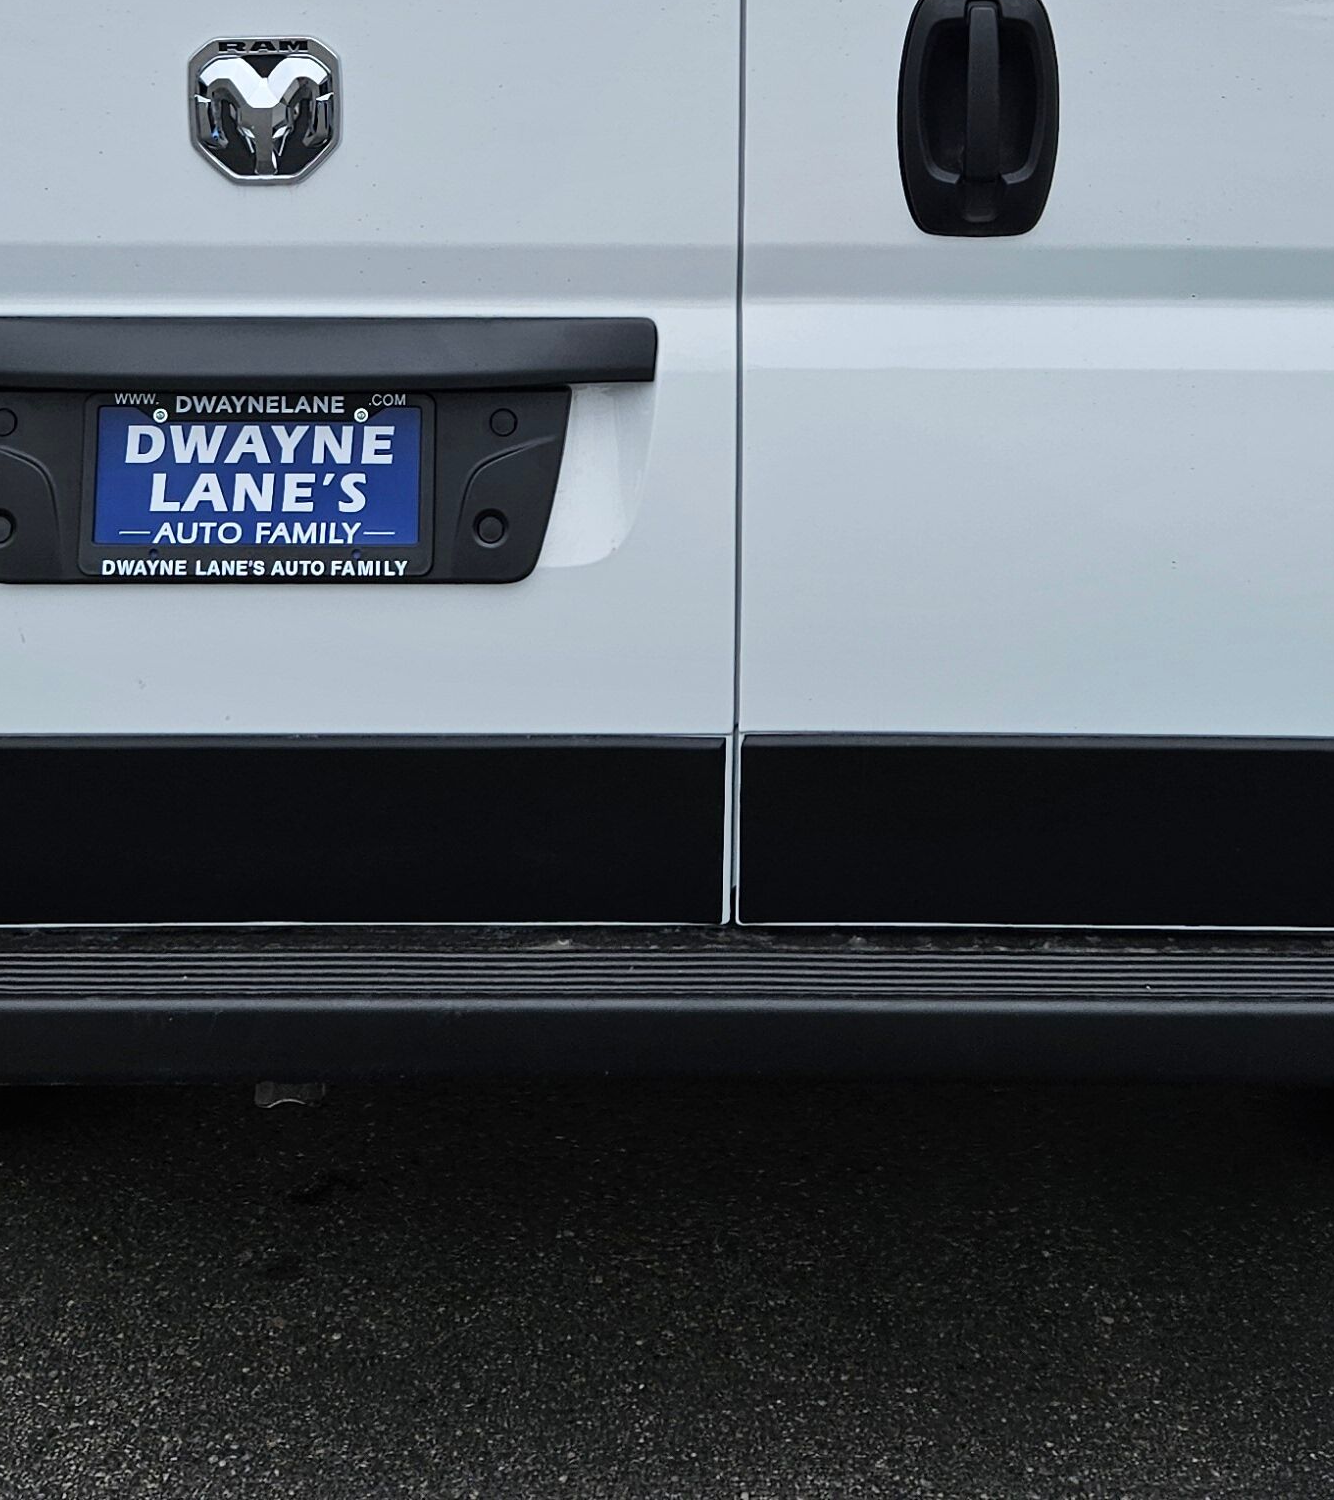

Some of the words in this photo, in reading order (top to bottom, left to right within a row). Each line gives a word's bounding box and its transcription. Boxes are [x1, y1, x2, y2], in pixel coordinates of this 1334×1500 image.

[217, 40, 309, 53] RAM
[175, 394, 346, 414] DWAYNELANE
[124, 424, 395, 465] DWAYNE
[149, 472, 367, 513] LANE'S
[151, 521, 243, 544] AUTO
[254, 521, 362, 545] FAMILY
[101, 559, 188, 576] DWAYNE
[194, 559, 266, 577] LANE'S
[270, 560, 326, 577] AUTO
[330, 560, 408, 577] FAMILY
